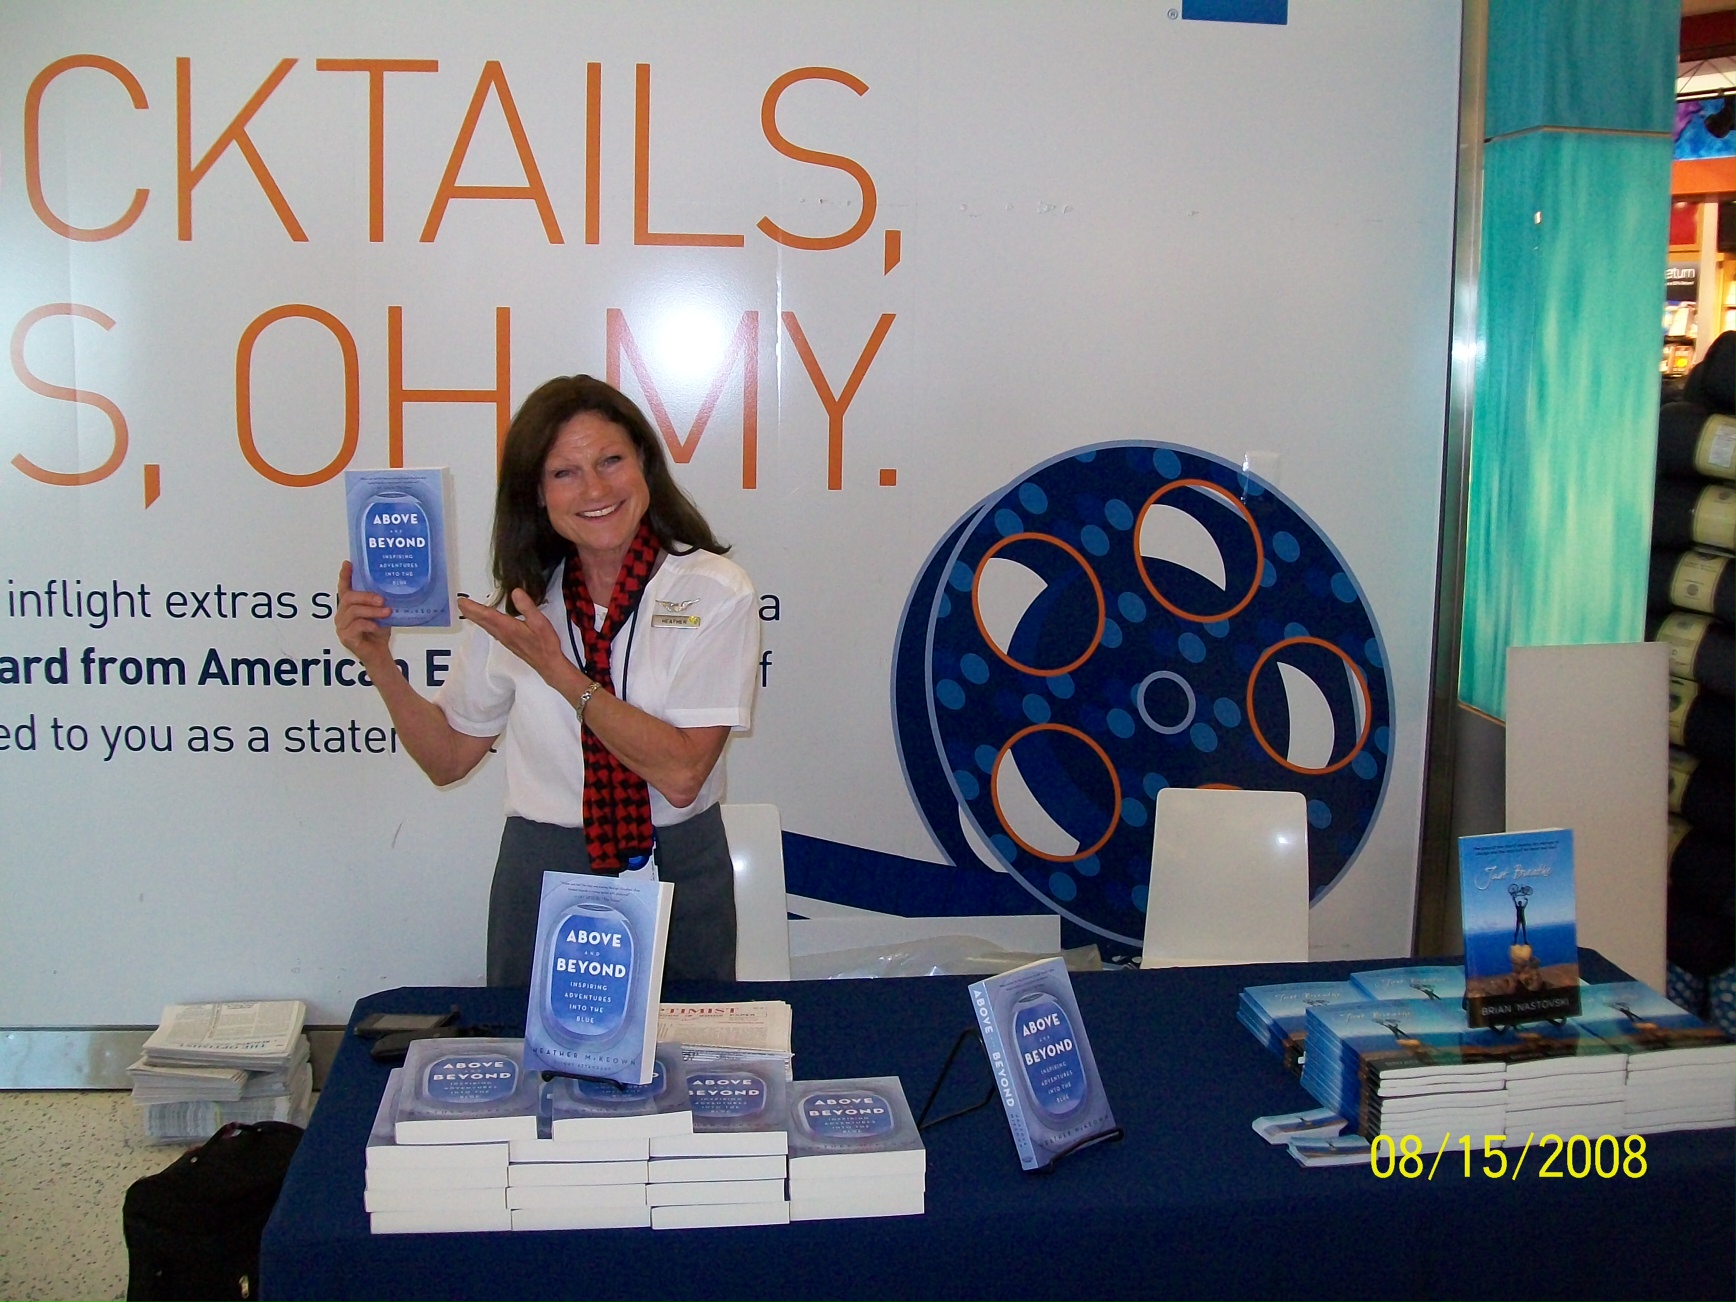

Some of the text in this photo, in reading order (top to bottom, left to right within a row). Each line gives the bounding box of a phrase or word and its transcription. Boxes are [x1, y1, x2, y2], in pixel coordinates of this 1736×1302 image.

[236, 303, 511, 487] OH
[606, 308, 896, 491] MY.
[373, 513, 418, 525] ABOVE
[369, 537, 426, 548] BEYOND
[8, 579, 151, 628] inflight
[165, 584, 298, 619] extras
[81, 647, 186, 685] from
[51, 717, 88, 751] to
[100, 725, 172, 761] you
[187, 725, 234, 752] as
[247, 725, 269, 752] a
[566, 929, 622, 948] ABOVE
[556, 957, 626, 978] BEYOND
[570, 981, 608, 991] INSPIRING
[564, 992, 612, 1003] ADVENTURES
[569, 1004, 603, 1013] INTO THE
[1481, 999, 1570, 1016] BRIAN NASTOVSKI
[576, 1015, 594, 1024] BLUE
[1022, 1013, 1061, 1037] ABOVE
[533, 1047, 578, 1059] HEATHER
[973, 989, 1014, 1107] ABOVE BEYOND
[1024, 1038, 1073, 1066] BEYOND
[443, 1061, 504, 1069] ABOVE
[433, 1072, 511, 1081] BEYOND
[809, 1108, 884, 1116] BEYOND
